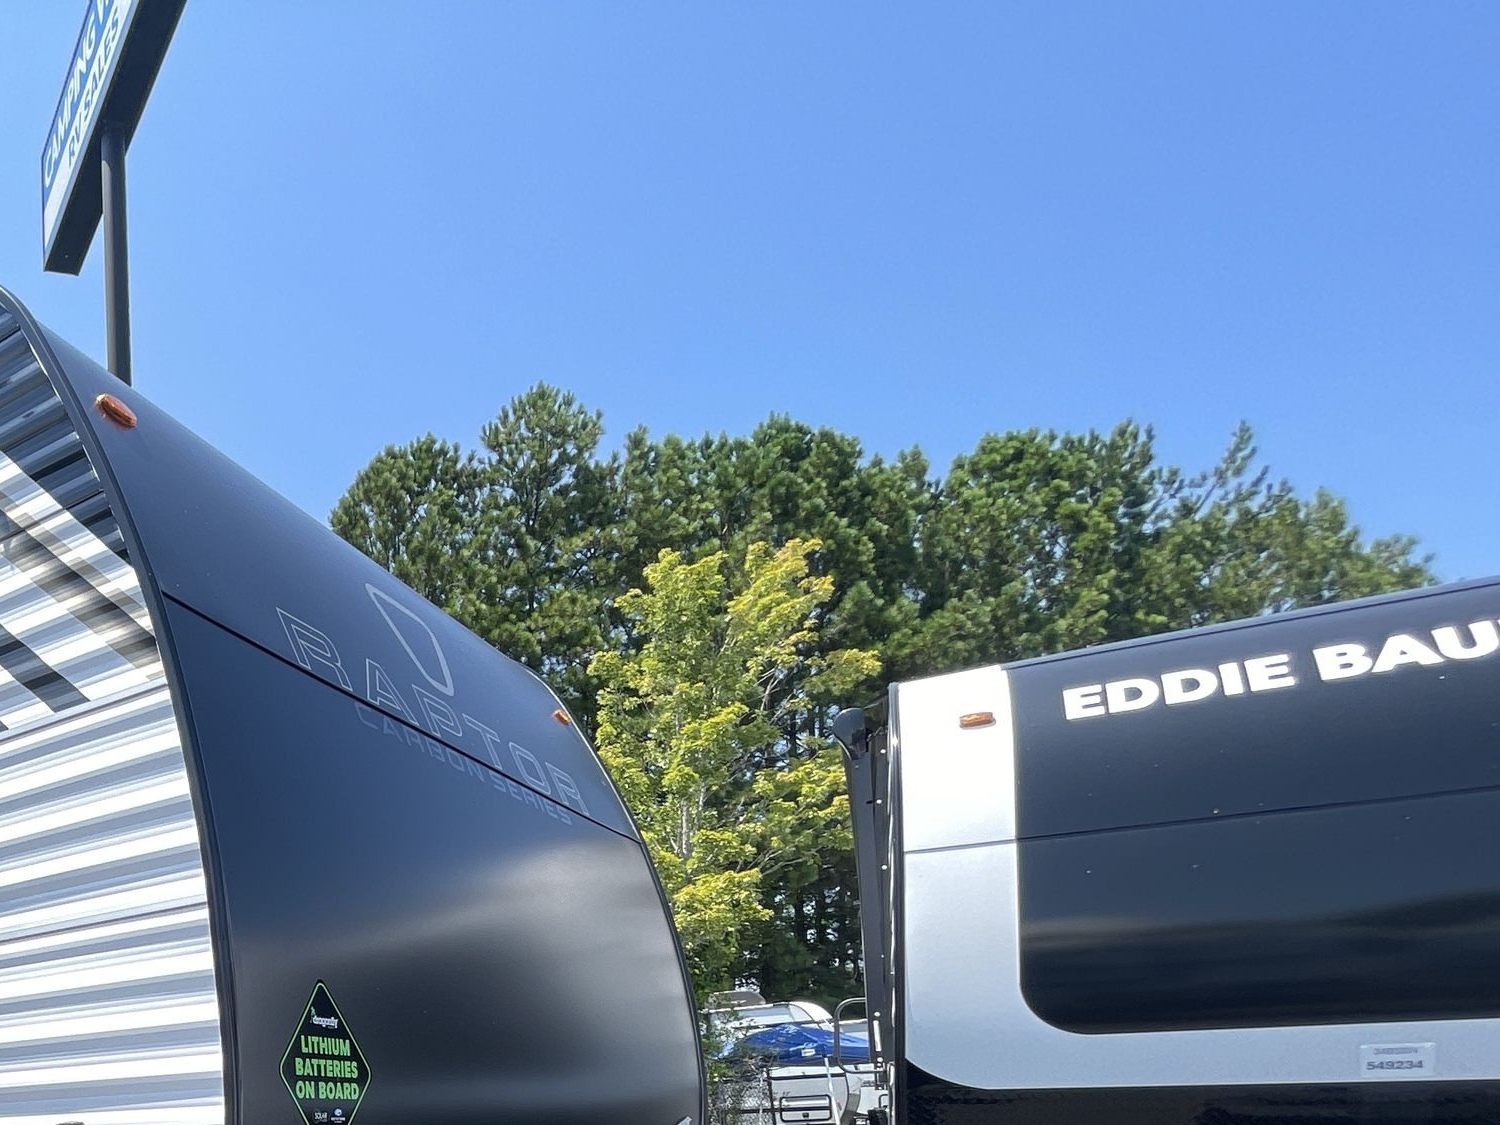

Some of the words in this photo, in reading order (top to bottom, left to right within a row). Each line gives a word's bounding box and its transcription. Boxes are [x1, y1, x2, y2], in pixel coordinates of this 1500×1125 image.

[44, 10, 96, 188] CAMPING
[83, 6, 119, 122] SALES
[275, 606, 590, 817] RAPTOR
[1062, 654, 1297, 721] EDDIE
[1312, 618, 1500, 682] BAU
[355, 702, 485, 783] CARBON
[489, 771, 573, 826] SERIES
[294, 1057, 359, 1079] BATTERIES
[295, 1080, 315, 1099] ON
[318, 1081, 360, 1100] BOARD
[300, 1035, 351, 1057] LITHIUM
